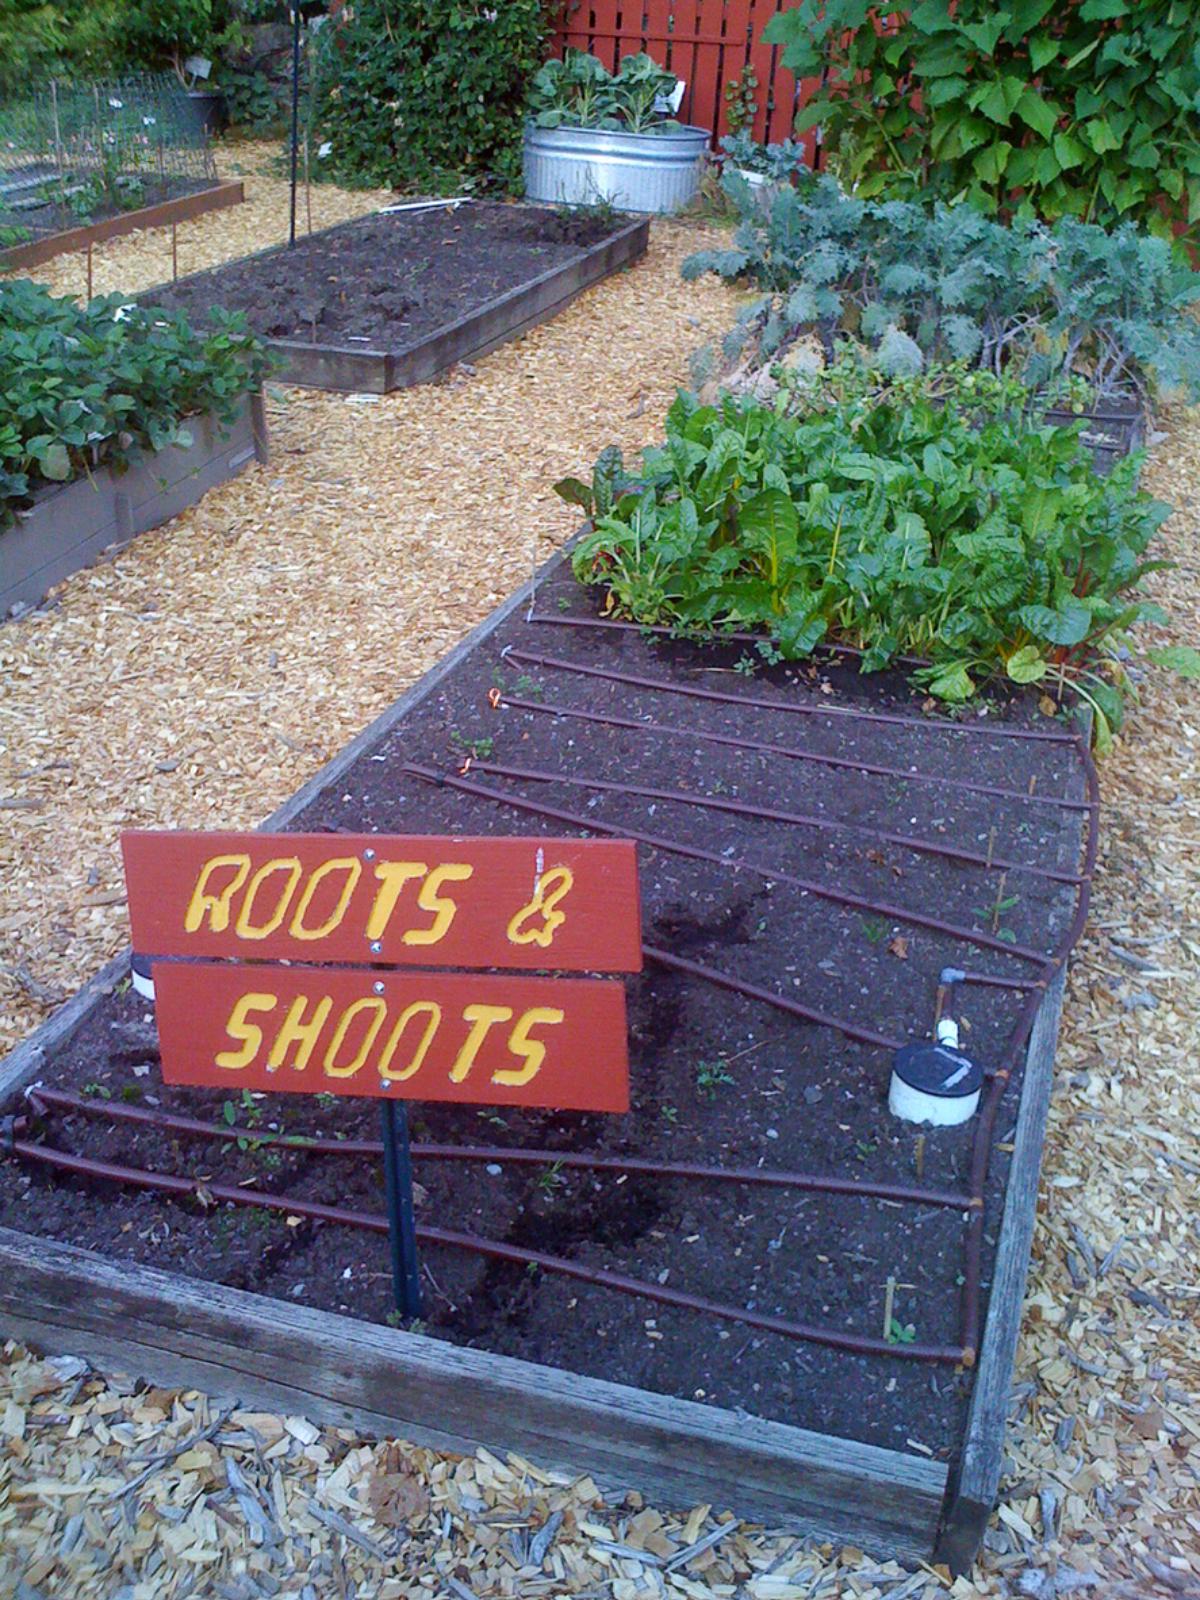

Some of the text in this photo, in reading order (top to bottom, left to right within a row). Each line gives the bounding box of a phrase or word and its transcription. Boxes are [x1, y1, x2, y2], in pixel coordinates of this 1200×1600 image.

[185, 855, 573, 946] ROOTS &
[215, 994, 565, 1085] SHOOTS
